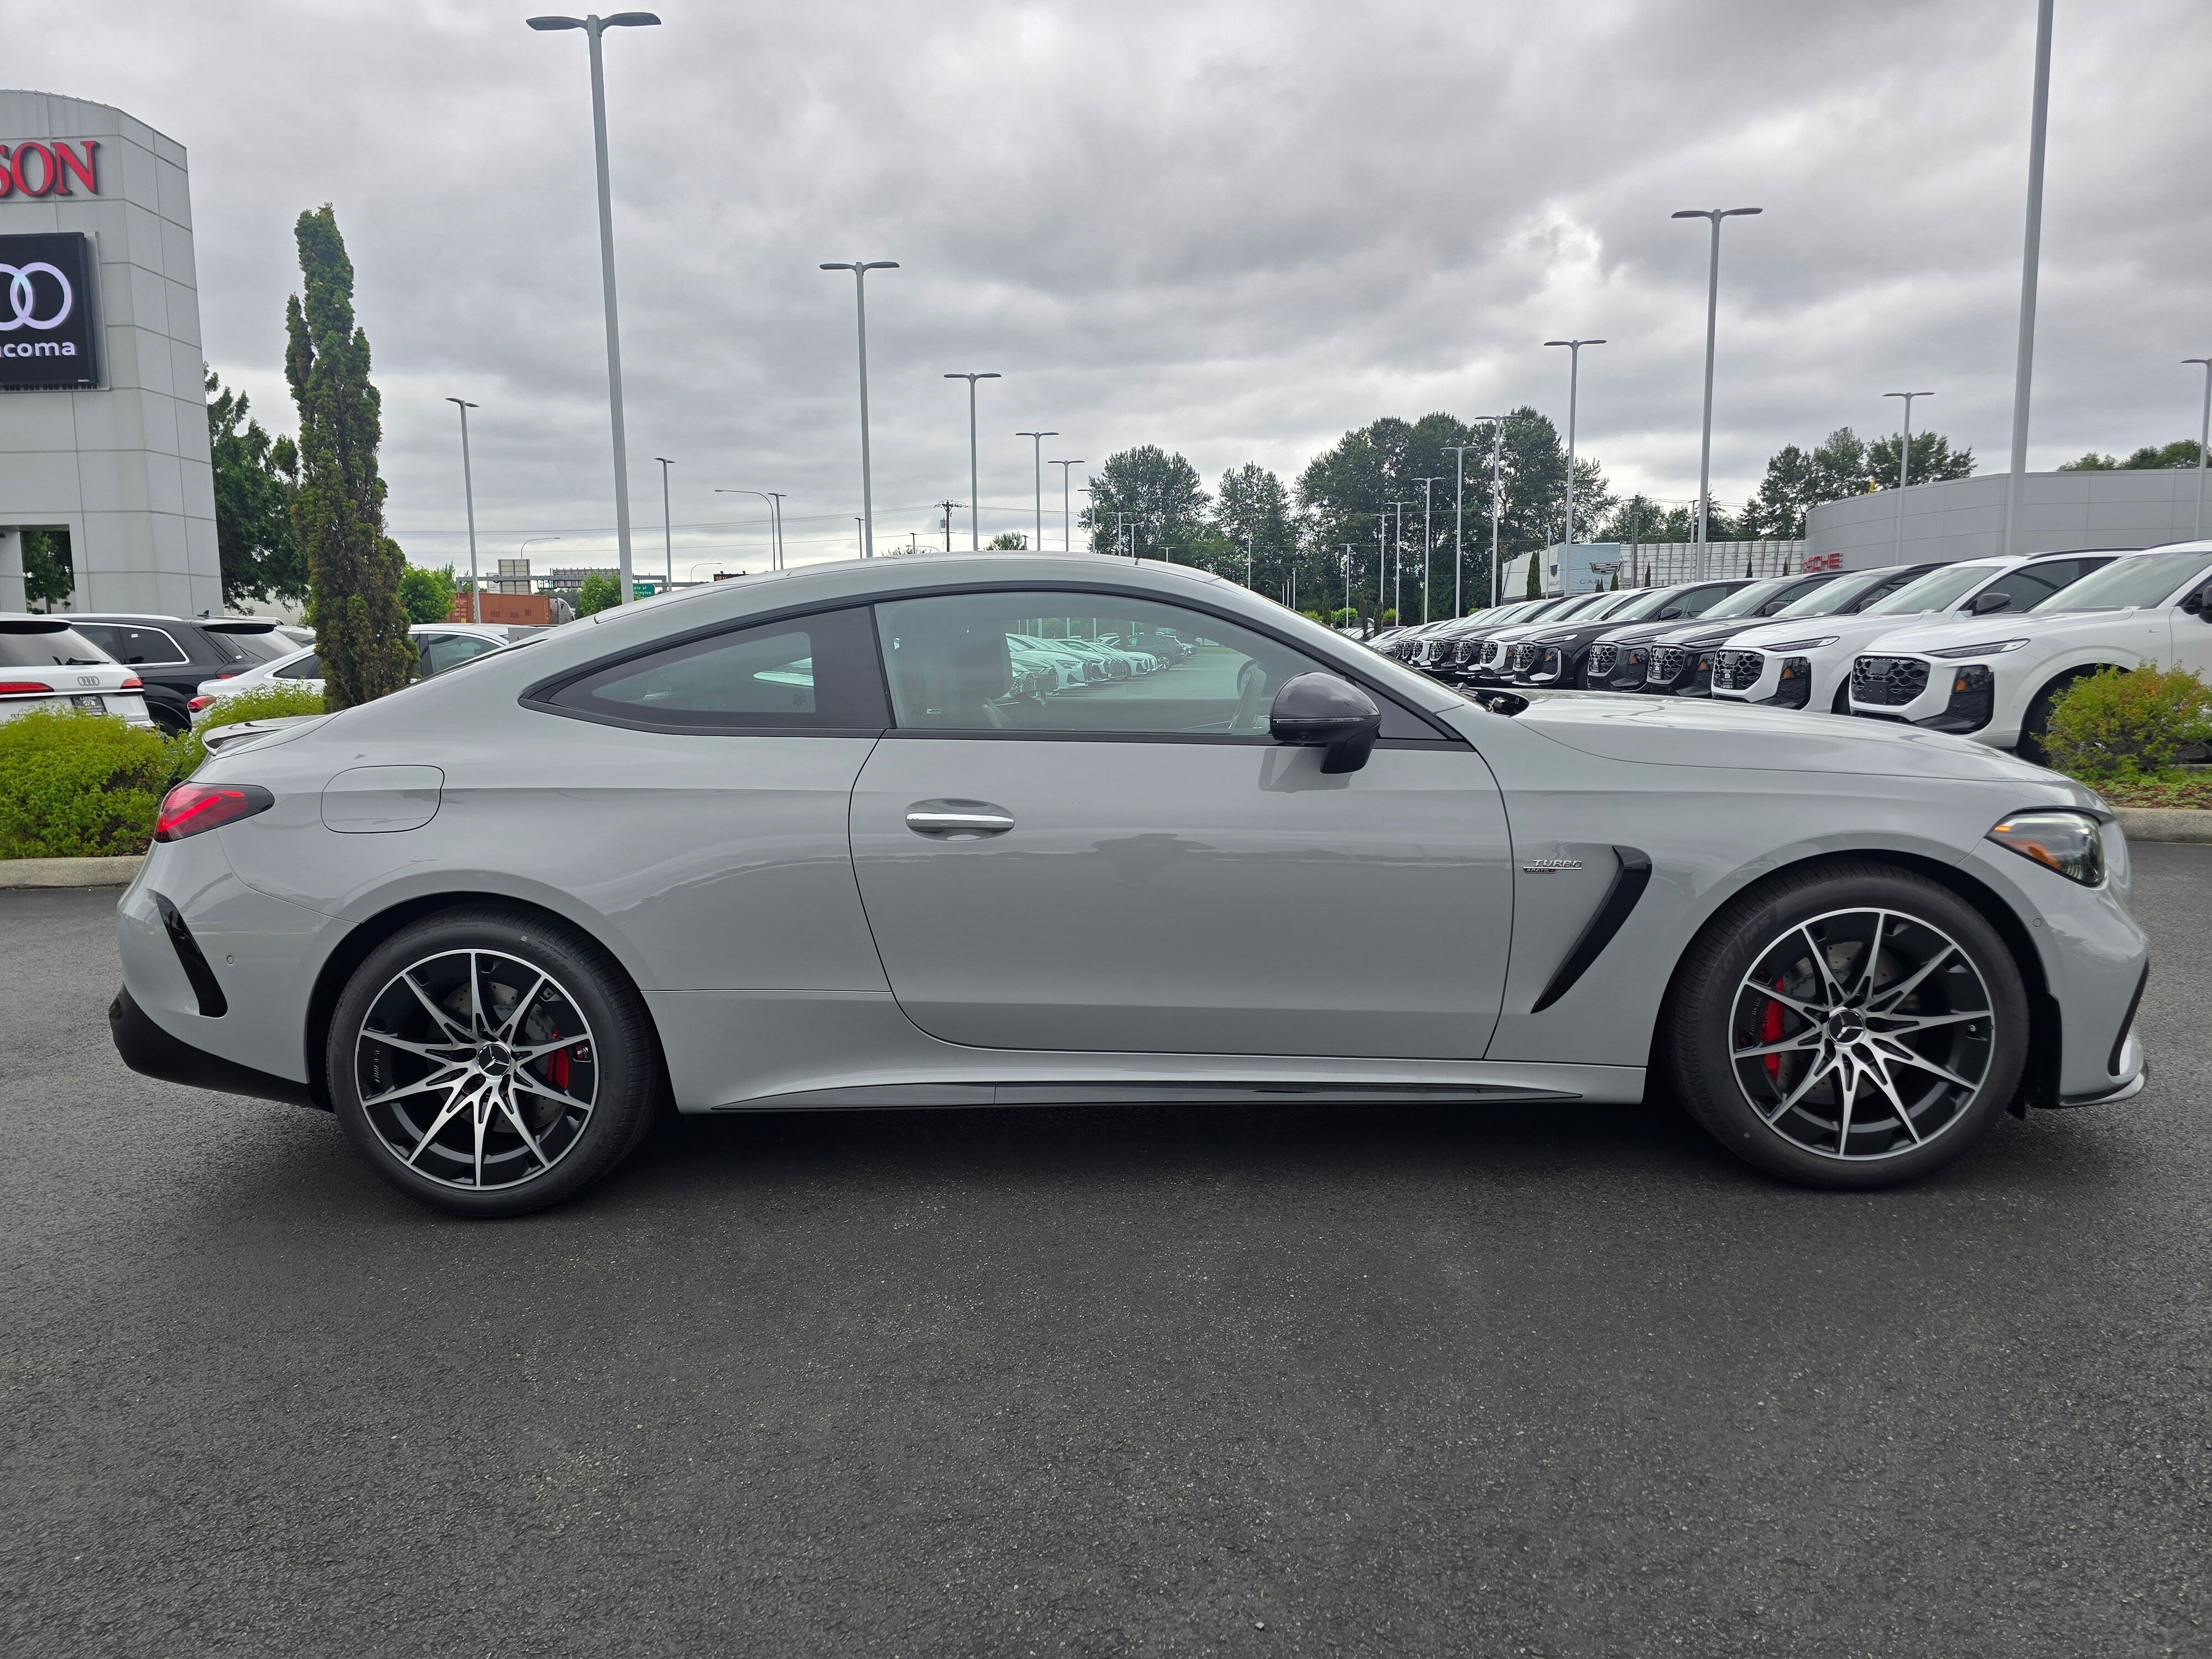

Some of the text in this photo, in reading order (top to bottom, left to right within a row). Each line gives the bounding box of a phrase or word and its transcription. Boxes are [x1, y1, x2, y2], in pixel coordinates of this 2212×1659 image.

[0, 342, 76, 357] coma
[1802, 553, 1843, 572] SCHE
[539, 941, 568, 960] OUTSIDE
